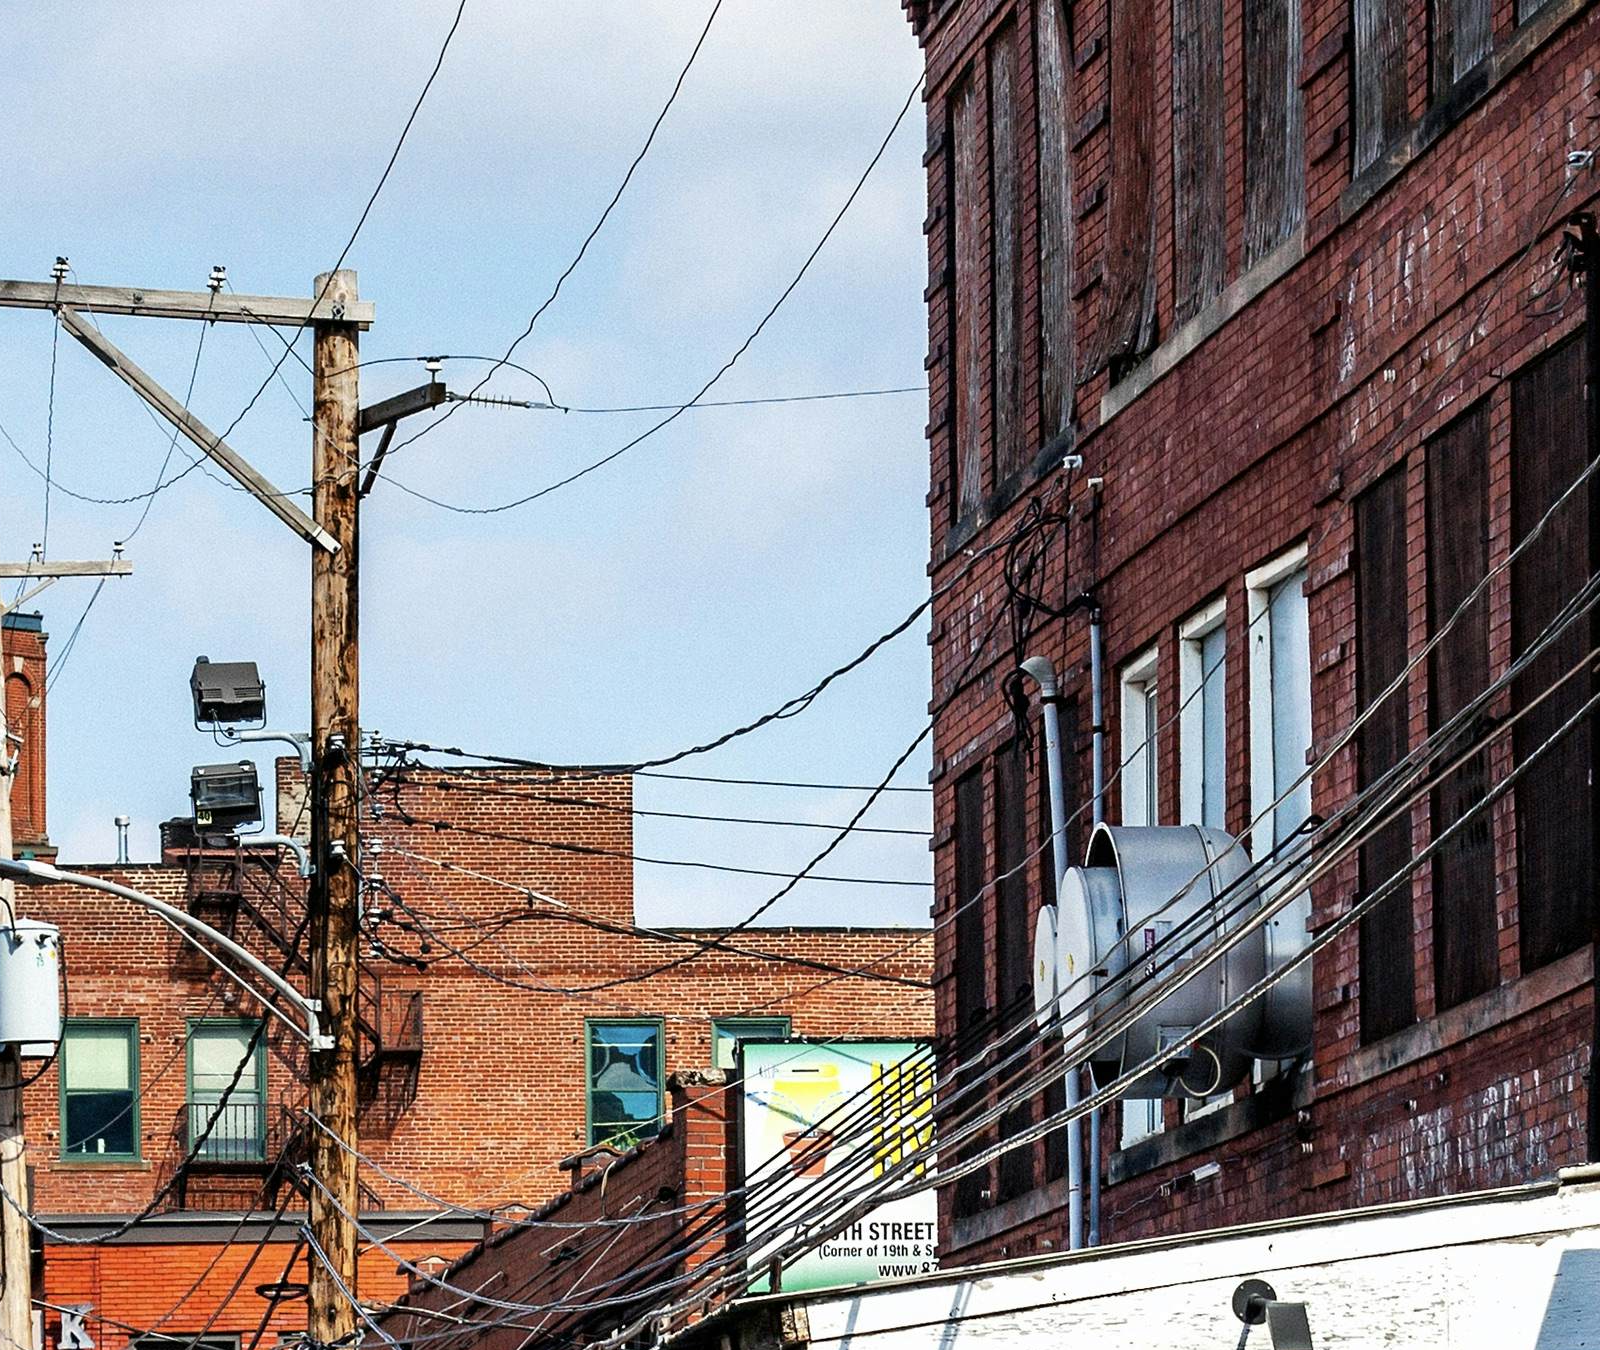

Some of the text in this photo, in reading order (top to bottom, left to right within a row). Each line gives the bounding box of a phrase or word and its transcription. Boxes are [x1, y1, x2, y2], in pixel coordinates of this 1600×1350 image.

[869, 1222, 934, 1241] STREET
[819, 1245, 862, 1260] (Corner
[866, 1245, 878, 1257] of
[882, 1245, 908, 1257] 19th
[913, 1245, 921, 1257] &
